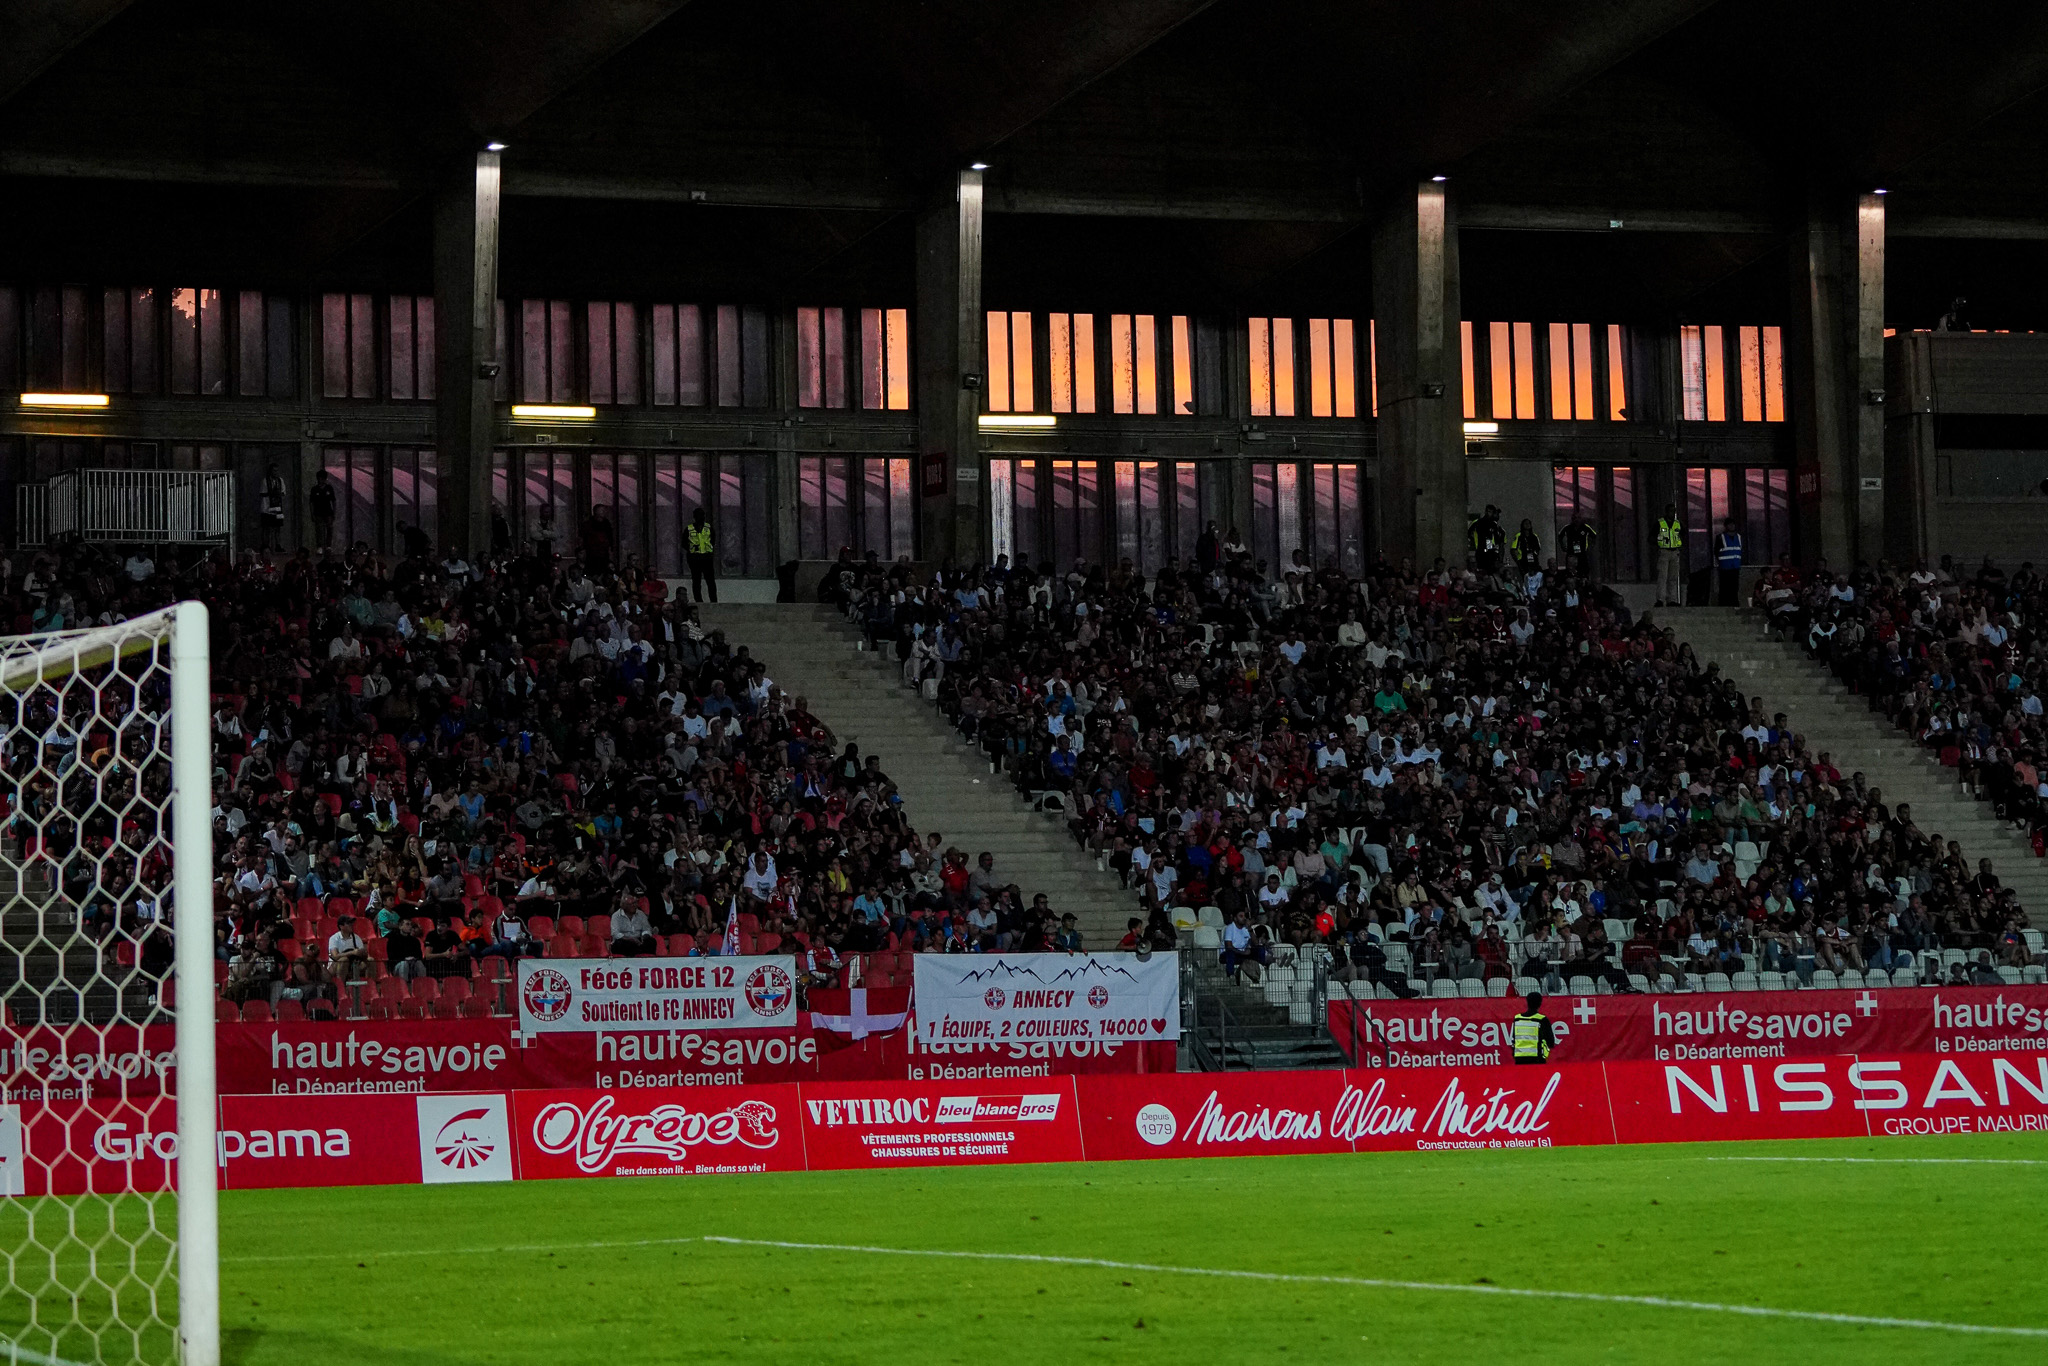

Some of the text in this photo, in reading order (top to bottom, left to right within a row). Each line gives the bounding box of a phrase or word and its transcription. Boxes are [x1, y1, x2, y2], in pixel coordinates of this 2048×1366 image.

[580, 966, 735, 990] Fécé FORCE 12
[1012, 990, 1075, 1008] ANNECY
[581, 997, 735, 1022] Soutient le FC ANNECY
[928, 1013, 1147, 1039] 1 ÉQUIPE, 2 COULEURS, 14000
[1654, 1041, 1785, 1060] le Département
[1935, 1035, 2048, 1052] le Départeme
[1366, 1050, 1500, 1068] le Département
[596, 1069, 743, 1088] le Département
[907, 1061, 1050, 1080] le Département
[272, 1076, 425, 1094] le Département
[1664, 1057, 2048, 1114] NISSAN
[806, 1097, 1055, 1125] VETIROC bleu blanc gros
[1141, 1112, 1170, 1122] Depuis
[1182, 1072, 1561, 1145] Maisons Alain Métral
[1141, 1123, 1172, 1135] 1979
[1883, 1116, 1972, 1135] GROUPE
[94, 1122, 351, 1168] Gropama
[861, 1131, 1015, 1145] VÊTEMENTS PROFESSIONNELS
[1417, 1139, 1486, 1150] Constructeur
[1488, 1138, 1502, 1149] de
[1504, 1138, 1535, 1148] valeur
[871, 1143, 1009, 1158] CHAUSSURES DE SÉCURITÉ
[616, 1167, 635, 1176] Bien
[636, 1166, 657, 1175] dans
[658, 1167, 674, 1175] son
[695, 1164, 714, 1174] Bien
[715, 1163, 736, 1173] dans
[737, 1165, 747, 1173] sa
